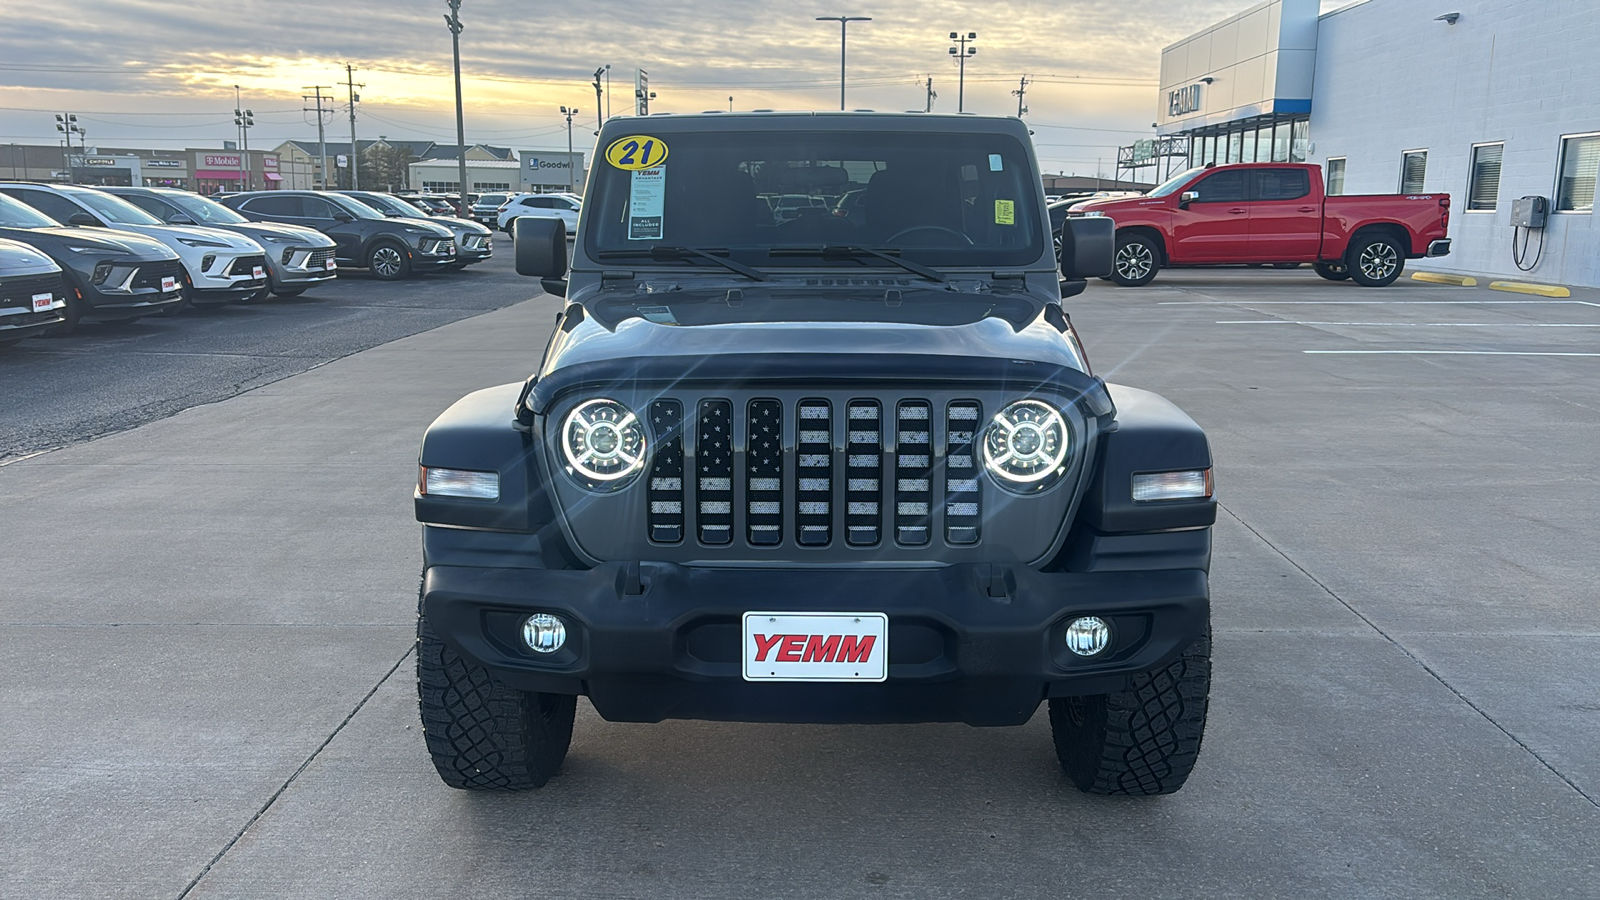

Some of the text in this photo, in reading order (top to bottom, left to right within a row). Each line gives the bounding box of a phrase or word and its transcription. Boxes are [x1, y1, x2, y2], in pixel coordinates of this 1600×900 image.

[539, 160, 575, 169] Goodwil
[619, 140, 654, 165] 21
[753, 633, 878, 663] YEMM
